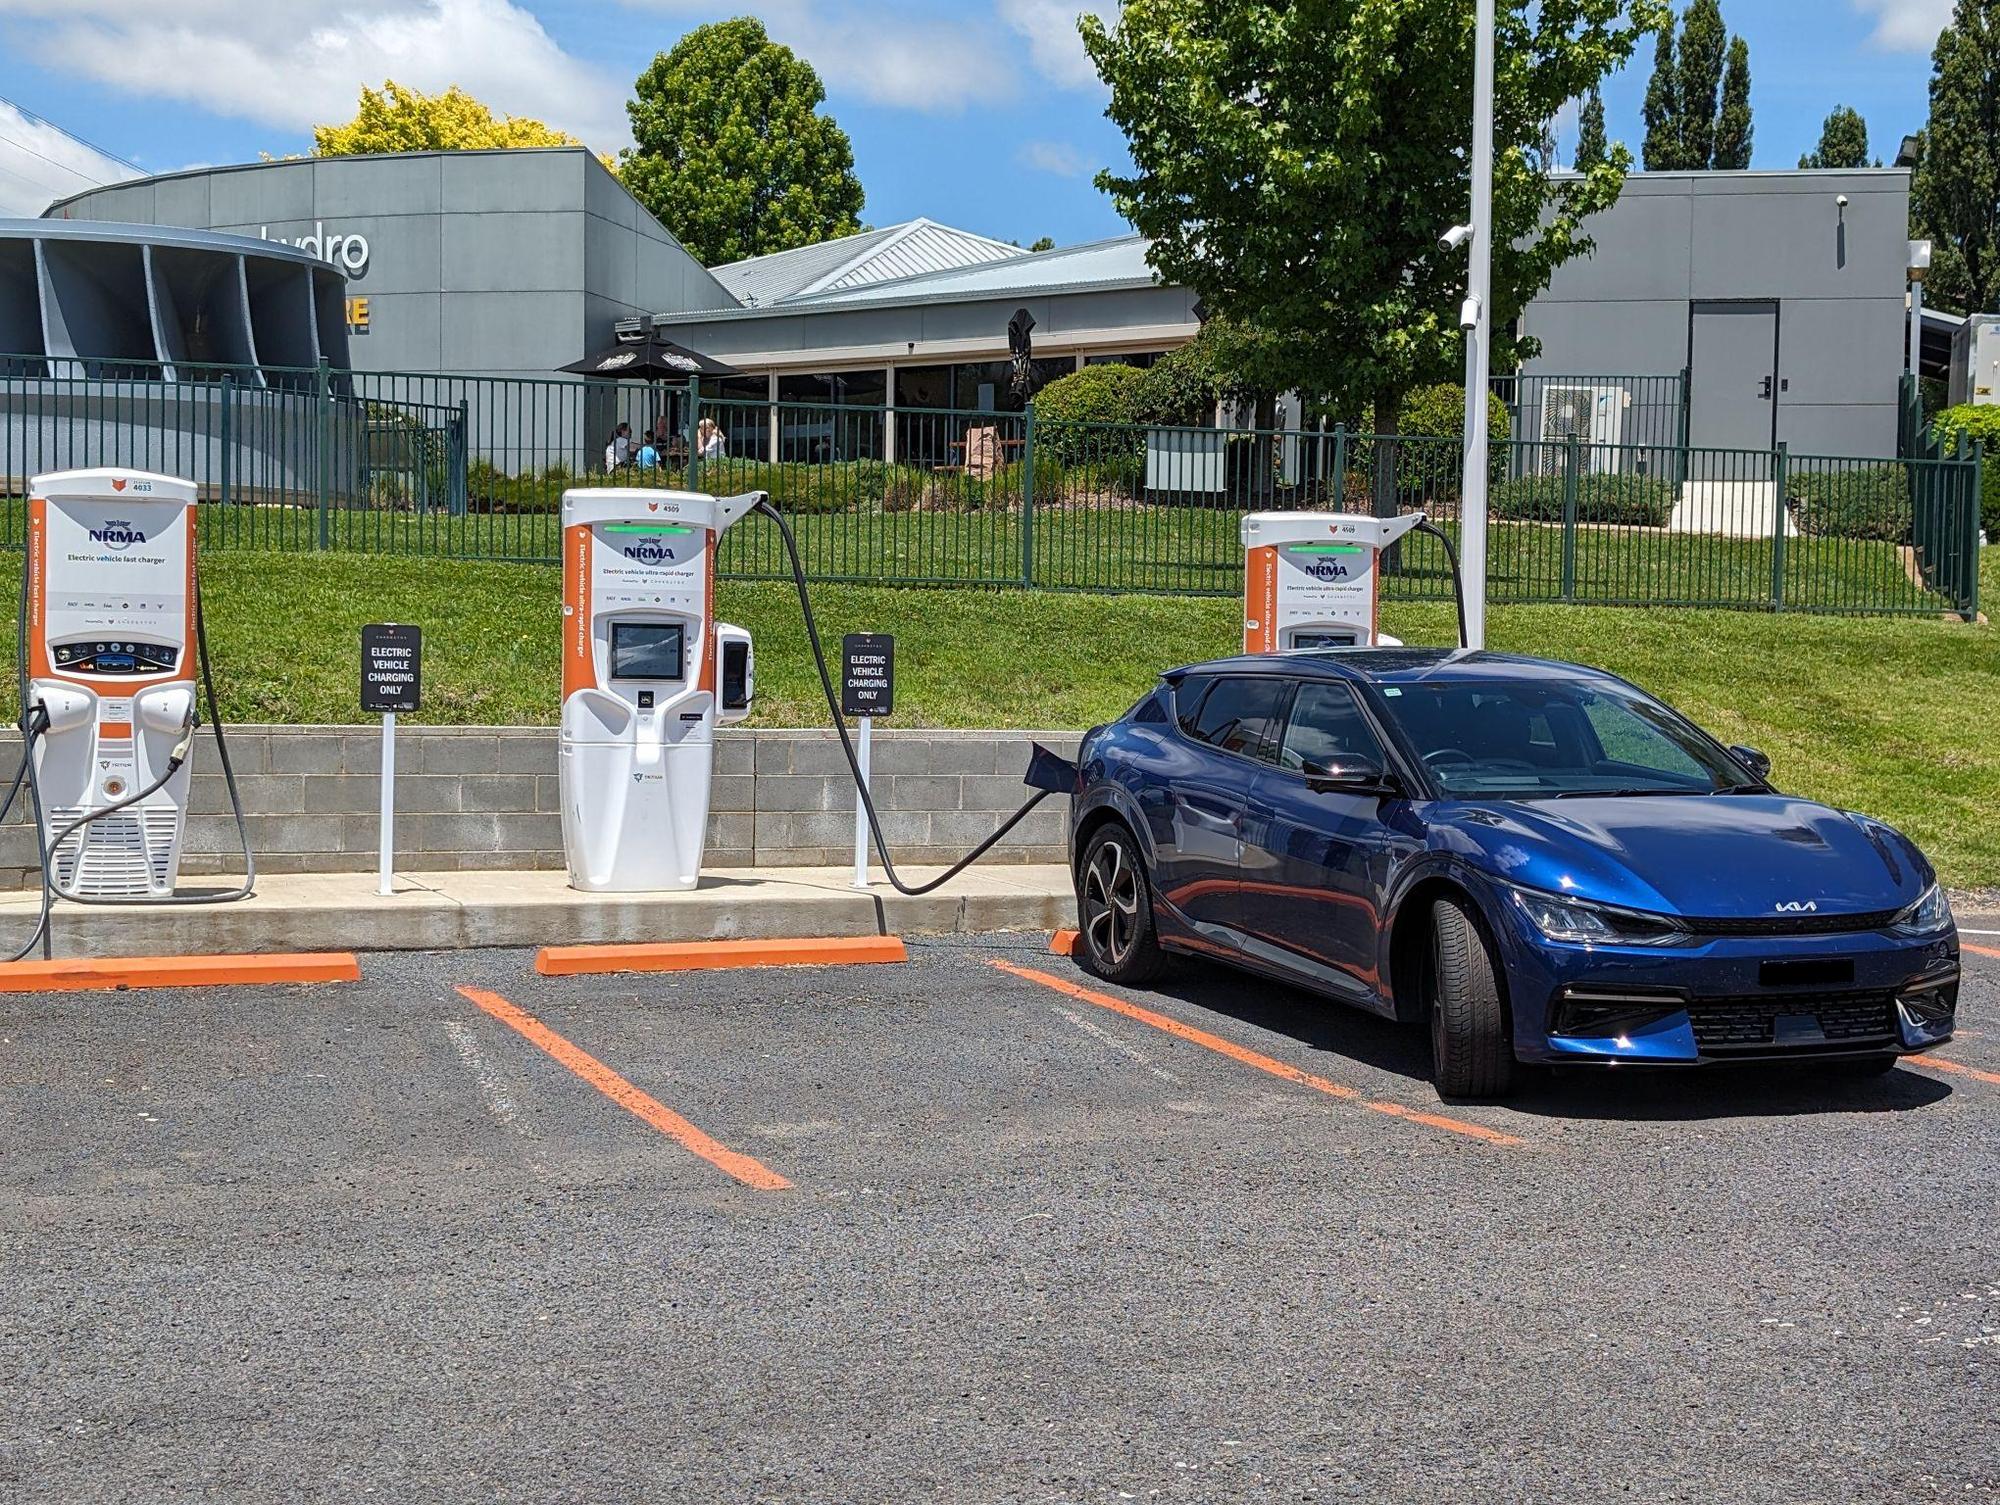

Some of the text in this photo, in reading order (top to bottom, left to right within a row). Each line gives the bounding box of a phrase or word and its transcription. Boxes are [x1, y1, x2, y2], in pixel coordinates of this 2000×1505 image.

[262, 222, 368, 268] dro
[89, 530, 146, 543] NRMA
[624, 547, 675, 559] NRMA
[138, 556, 165, 564] charger
[1305, 566, 1348, 576] NRMA
[371, 648, 412, 657] ELECTRIC
[851, 655, 886, 664] ELECTRIC
[373, 660, 409, 670] VEHICLE
[852, 667, 884, 676] VEHICLE
[368, 673, 414, 682] CHARGING
[848, 679, 887, 688] CHARGING
[380, 686, 402, 694] ONLY
[858, 691, 878, 700] ONLY
